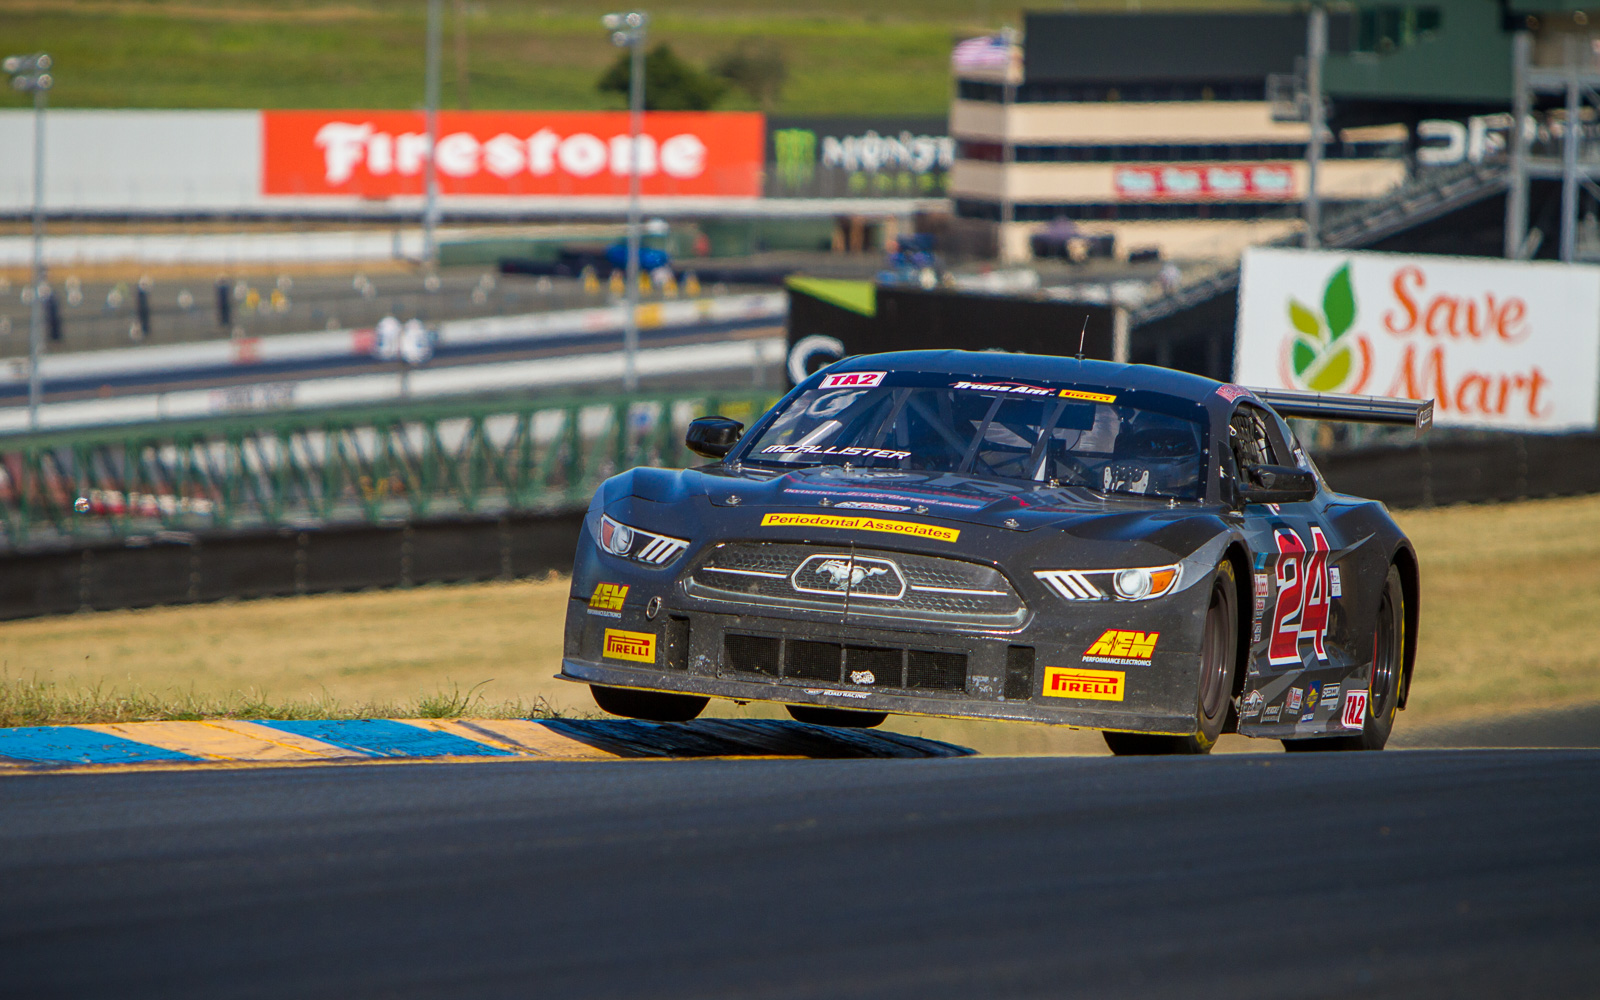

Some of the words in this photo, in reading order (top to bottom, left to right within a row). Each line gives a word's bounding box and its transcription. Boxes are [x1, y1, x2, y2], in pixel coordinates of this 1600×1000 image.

[315, 122, 705, 184] Firestone
[1385, 267, 1528, 341] Save
[830, 374, 878, 386] TA2
[954, 381, 1011, 392] Trans
[1383, 343, 1553, 419] Mart
[1065, 391, 1111, 401] PIRELLI
[761, 445, 912, 460] MCALLISTER
[768, 515, 860, 528] Periodontal
[862, 520, 951, 540] Associates
[588, 582, 630, 611] AEM
[1268, 526, 1332, 666] 24
[607, 635, 650, 657] PIRELLI
[1085, 630, 1160, 658] AEM
[1082, 656, 1120, 665] PERFORMANCE
[1120, 658, 1152, 667] ELECTRONICS
[1051, 674, 1118, 694] PIRELLI
[1344, 695, 1366, 725] TA2
